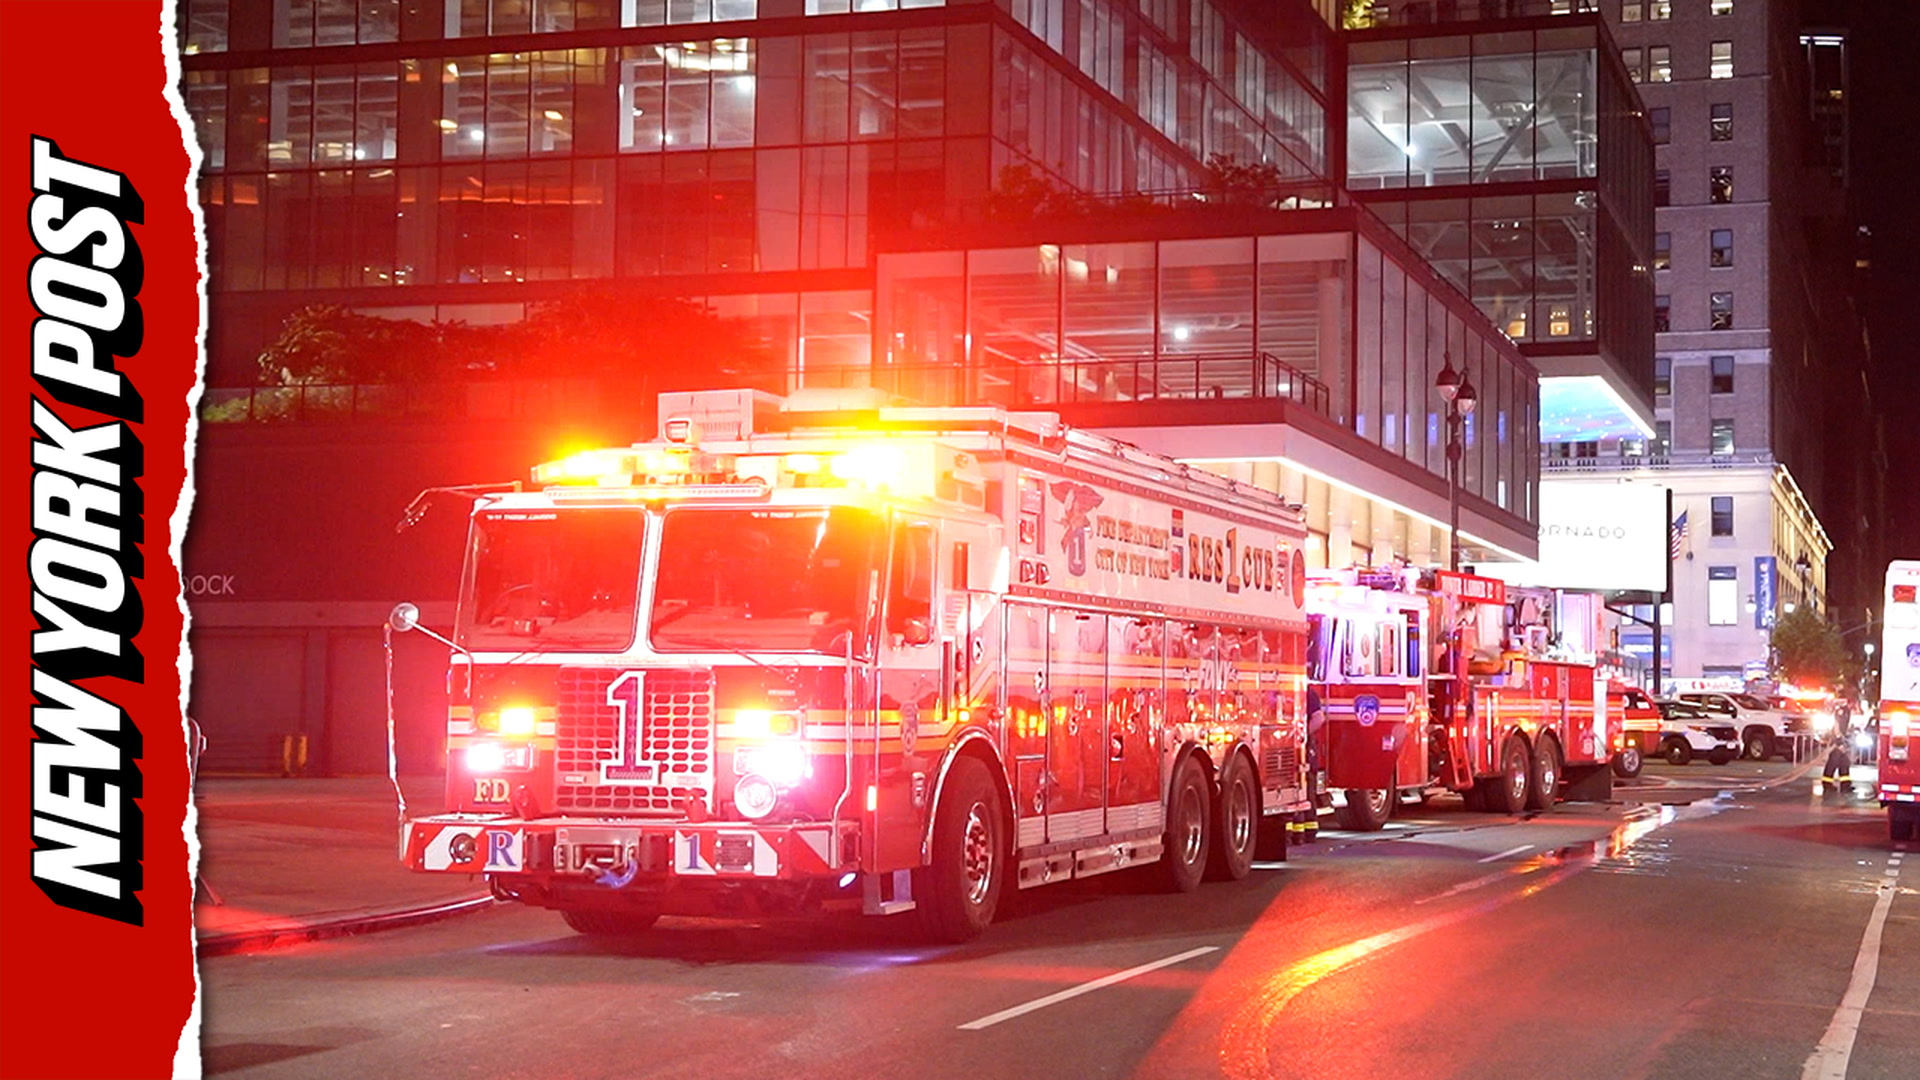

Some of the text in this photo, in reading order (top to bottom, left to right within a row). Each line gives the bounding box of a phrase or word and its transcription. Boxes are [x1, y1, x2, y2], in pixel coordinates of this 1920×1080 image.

[600, 670, 663, 786] 1
[486, 830, 517, 867] R
[684, 833, 704, 870] 1
